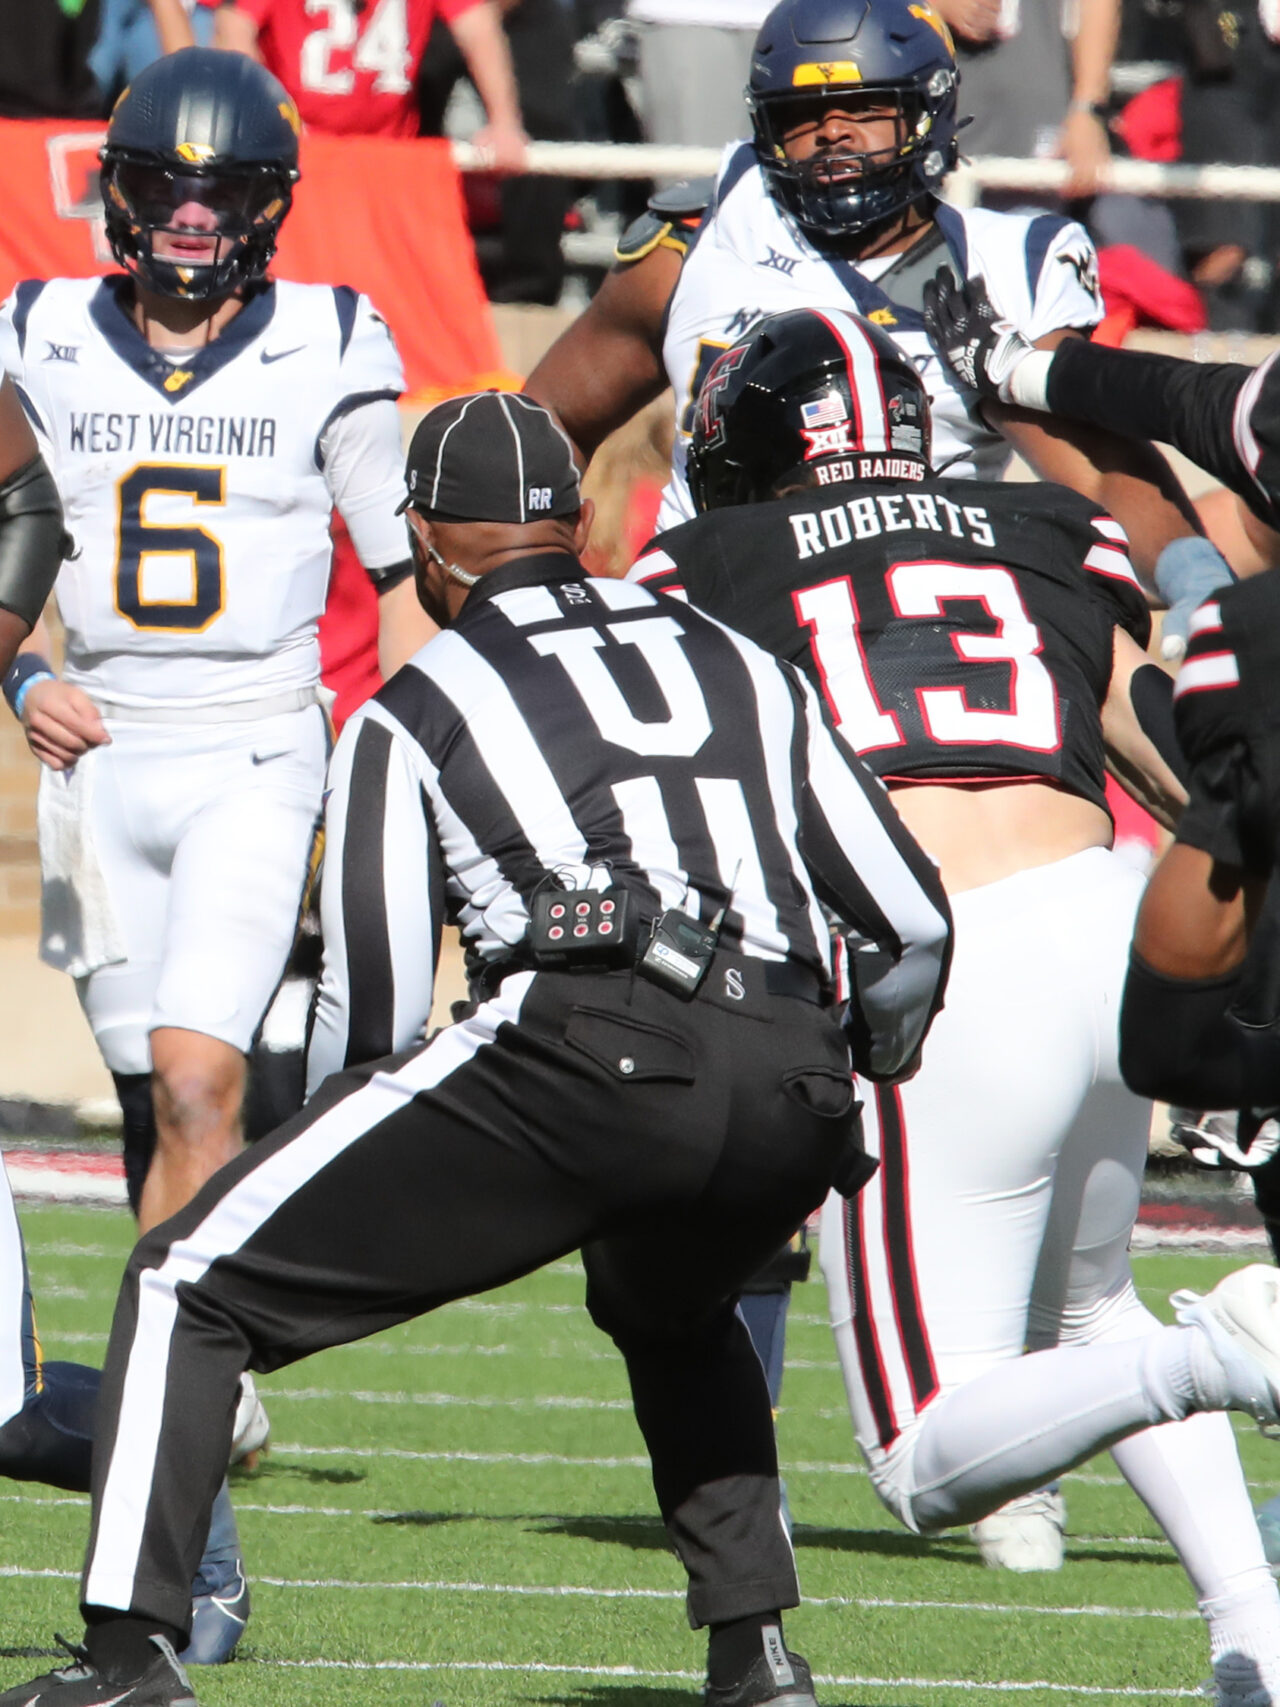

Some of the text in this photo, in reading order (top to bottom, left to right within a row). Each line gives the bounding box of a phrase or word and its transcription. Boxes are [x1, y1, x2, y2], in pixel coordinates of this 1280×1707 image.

[300, 0, 413, 95] 24
[758, 246, 803, 278] XII
[69, 412, 277, 458] WEST VIRGINIA
[801, 420, 857, 460] XII
[815, 458, 926, 486] RED RAIDERS
[528, 487, 552, 511] RR
[112, 461, 228, 633] 6
[789, 494, 996, 560] ROBERTS
[791, 559, 1063, 757] 13
[526, 616, 714, 757] U
[768, 1637, 785, 1667] NIKE
